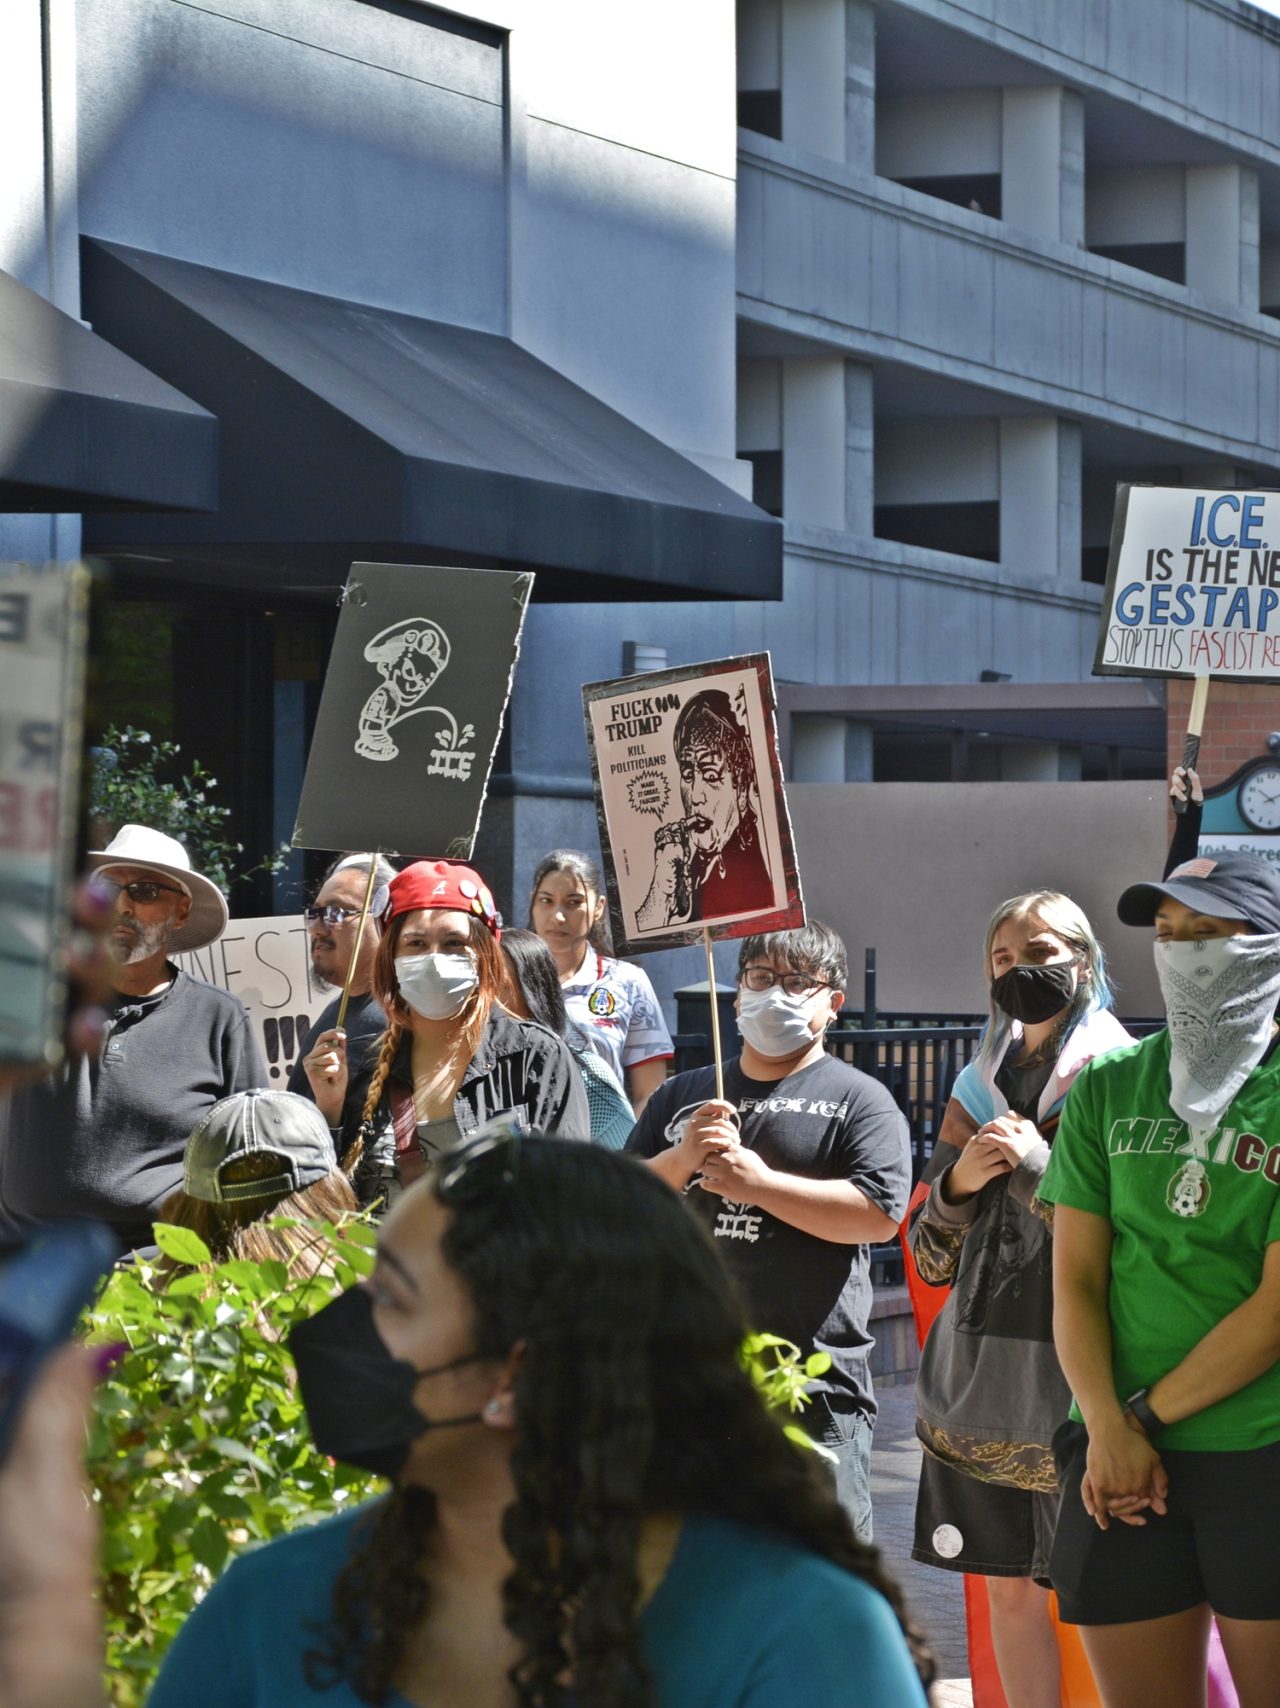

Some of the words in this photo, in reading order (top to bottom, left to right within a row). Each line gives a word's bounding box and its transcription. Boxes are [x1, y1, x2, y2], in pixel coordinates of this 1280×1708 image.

[1145, 548, 1174, 581] IS
[1183, 549, 1240, 584] THE
[1105, 625, 1142, 664] STOP
[1143, 628, 1184, 669] THIS
[1189, 630, 1259, 669] FASCIST
[611, 697, 654, 721] FUCK
[605, 715, 662, 742] TRUMP
[610, 754, 666, 774] POLITICIANS
[627, 744, 646, 757] KILL
[427, 749, 476, 781] ICE
[738, 1097, 807, 1114] FUCK
[714, 1213, 763, 1243] ICE
